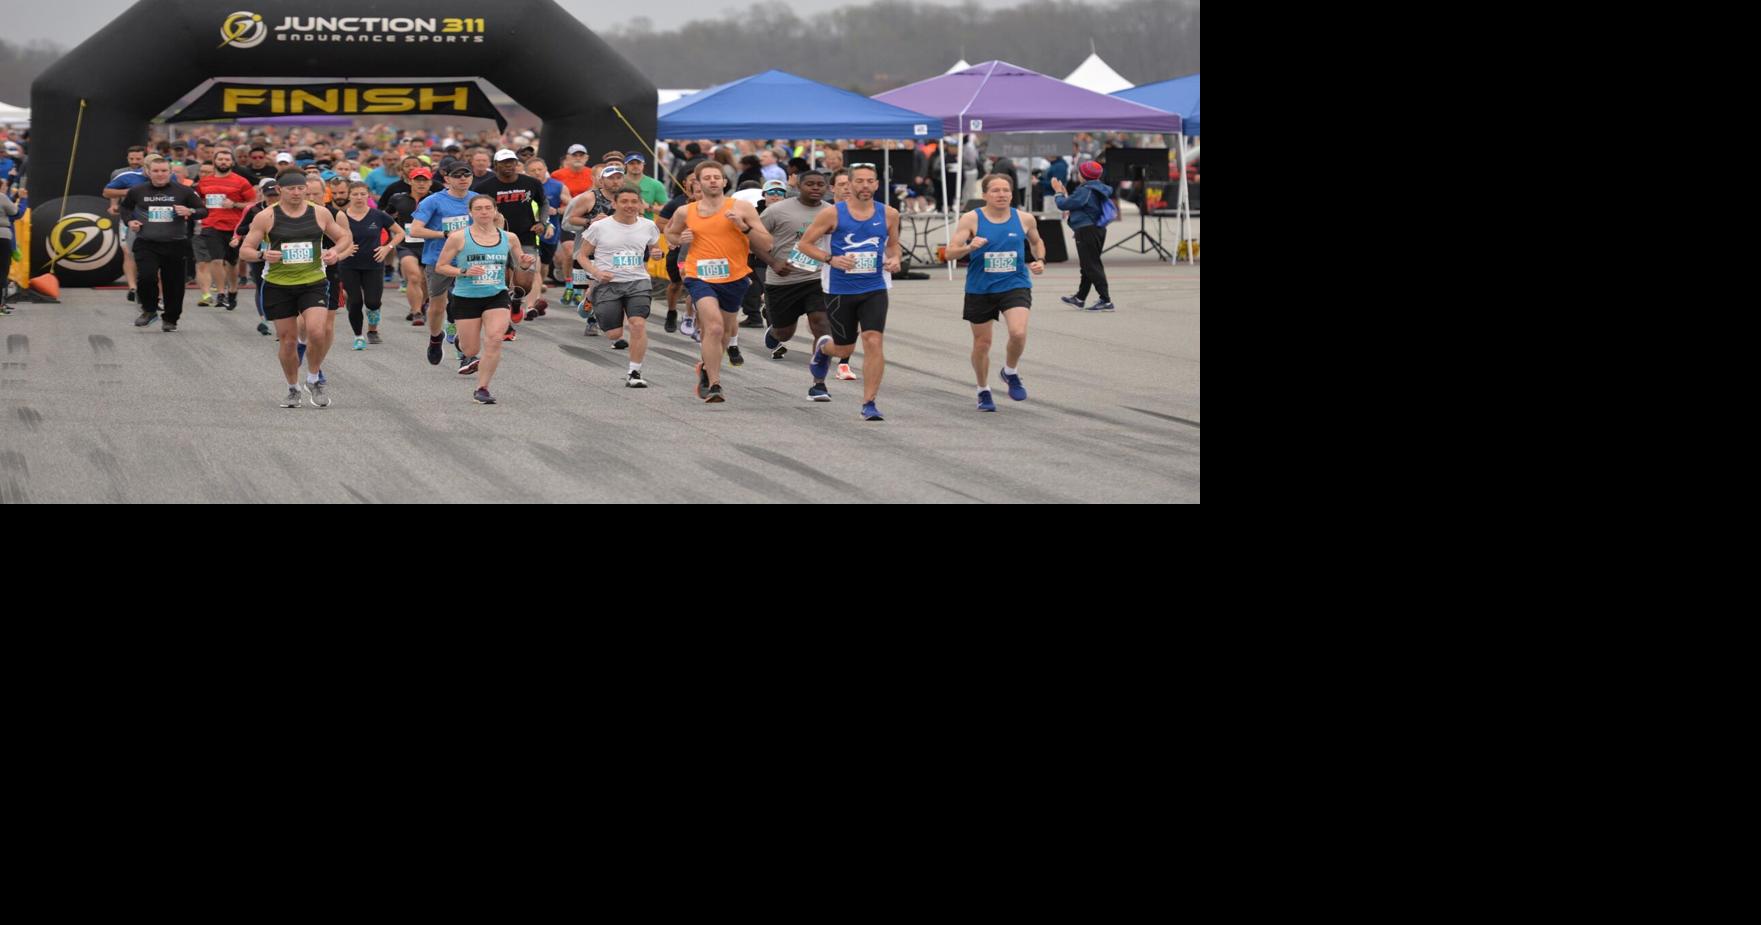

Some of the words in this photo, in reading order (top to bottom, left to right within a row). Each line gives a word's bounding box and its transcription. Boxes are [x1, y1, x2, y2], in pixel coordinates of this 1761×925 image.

[274, 16, 436, 32] JUNCTION
[441, 18, 485, 32] 311
[276, 33, 396, 42] ENDURANCE
[223, 87, 468, 114] FINISH
[286, 249, 310, 260] 1589
[702, 264, 726, 276] 1091
